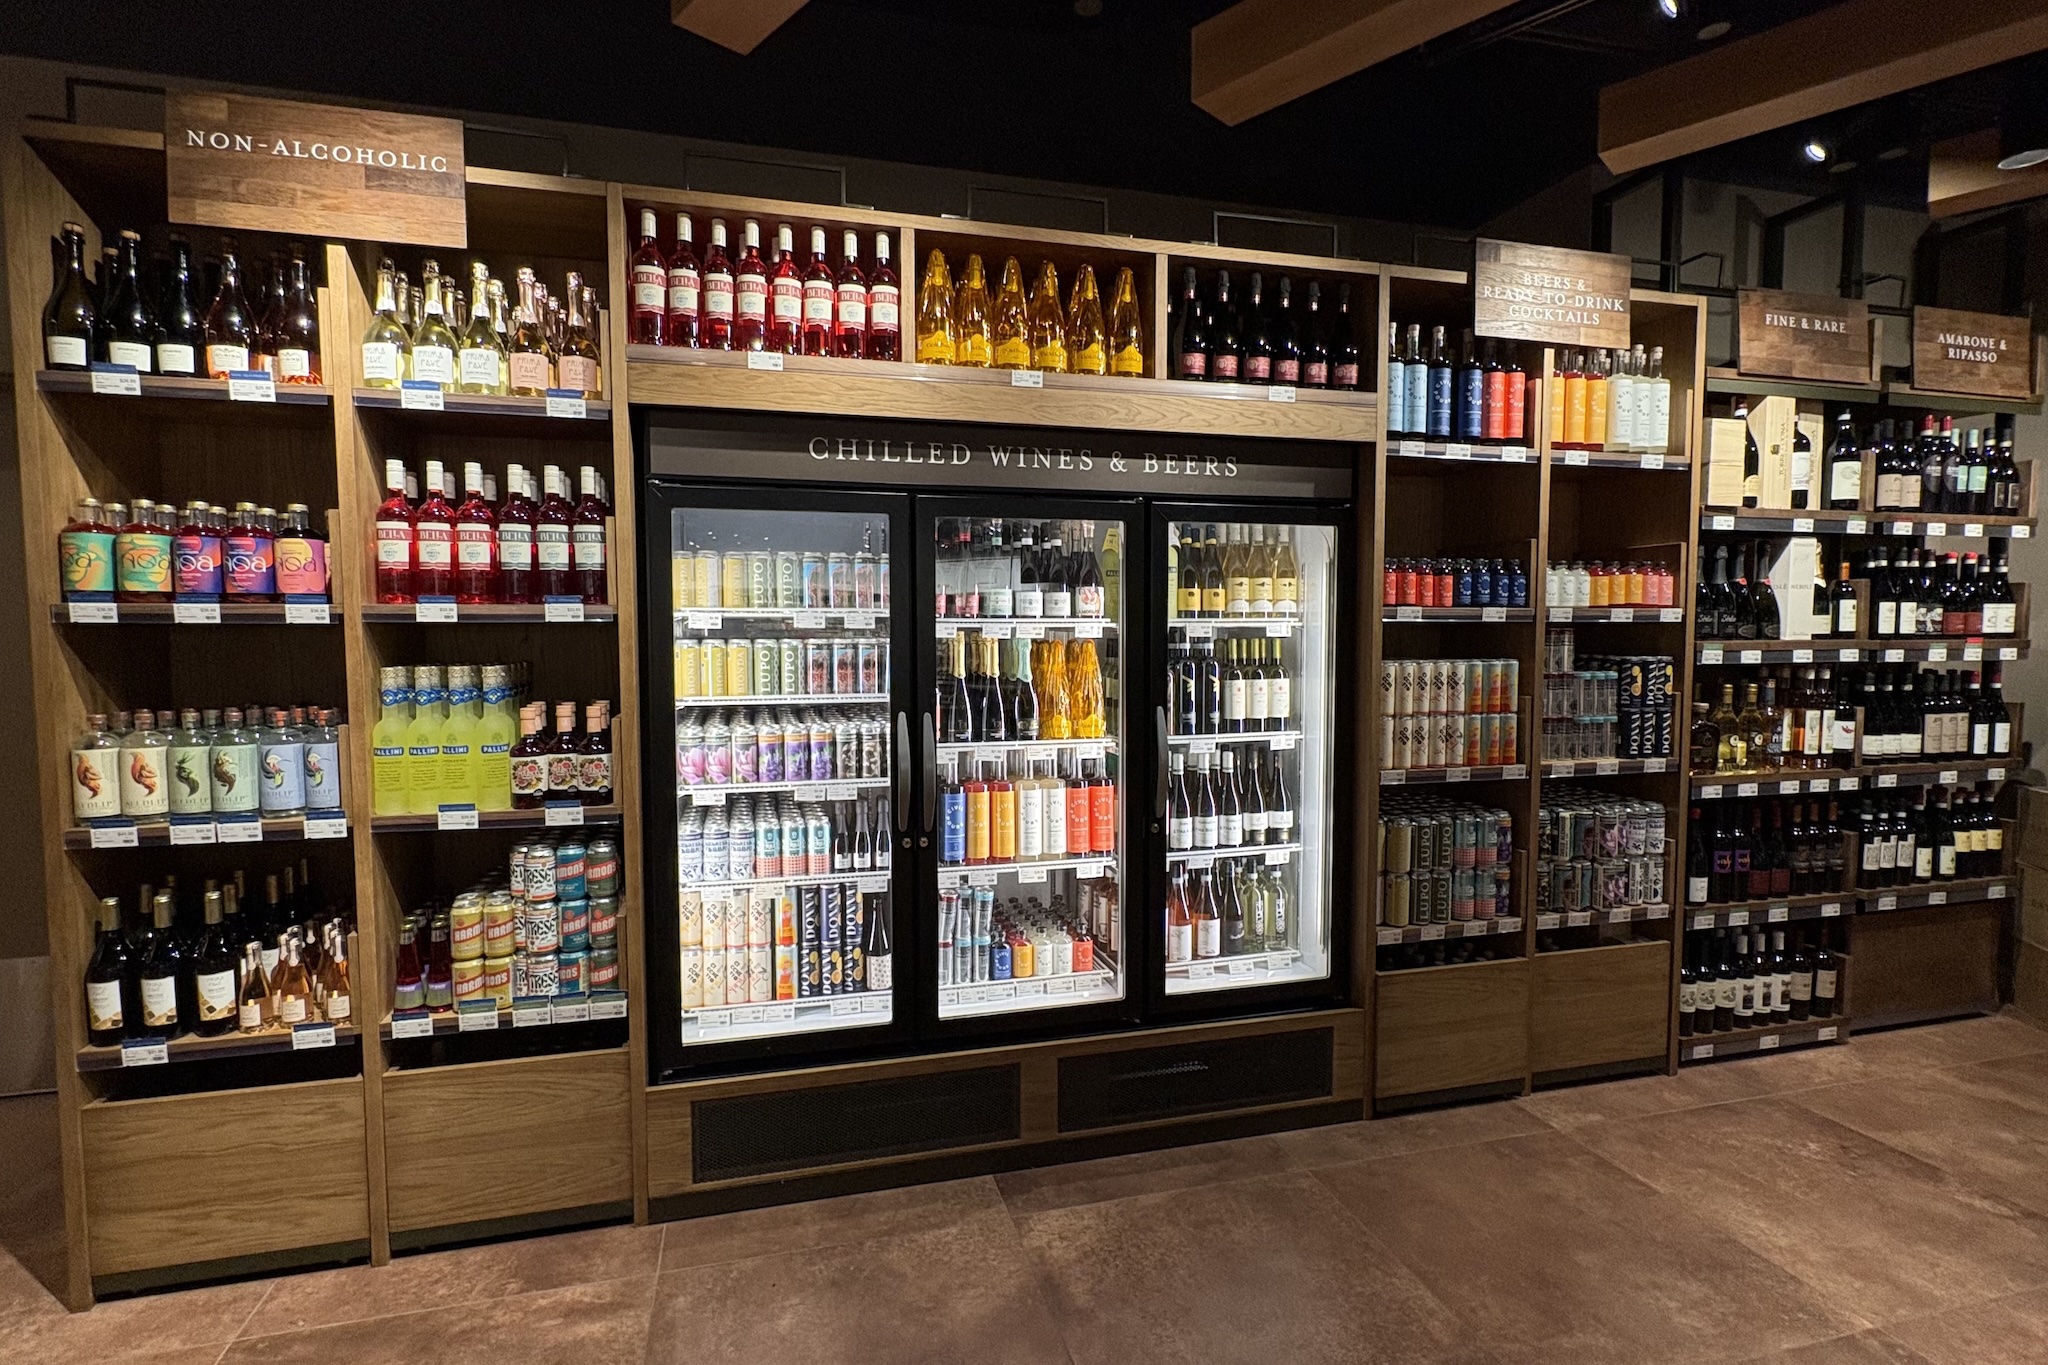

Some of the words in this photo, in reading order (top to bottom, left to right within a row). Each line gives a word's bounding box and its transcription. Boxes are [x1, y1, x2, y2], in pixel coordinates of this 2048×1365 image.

[186, 129, 448, 173] NON-ALCOHOLIC
[1523, 273, 1572, 290] BEERS
[1576, 279, 1587, 292] &
[1508, 304, 1601, 326] COCKTAILS
[1765, 312, 1796, 328] FINE
[1801, 317, 1809, 330] &
[1814, 319, 1847, 333] RARE
[1937, 333, 1996, 349] AMARONE
[1999, 338, 2008, 350] &
[1947, 347, 1998, 364] RIPASSO
[808, 436, 972, 466] CHILLED
[987, 444, 1094, 471] WINES
[1109, 449, 1128, 473] &
[1143, 452, 1239, 478] BEERS
[122, 552, 171, 570] noa
[754, 562, 764, 605] LUPO
[782, 562, 793, 605] LUPO
[760, 650, 770, 693] LUPO
[784, 651, 795, 693] LUPO
[443, 745, 468, 754] ALLINI
[483, 744, 508, 753] PALLIN
[1420, 828, 1430, 866] LUPO
[1441, 826, 1452, 865] LUPO
[1420, 882, 1429, 920] LUPO
[1437, 880, 1448, 918] LUPO
